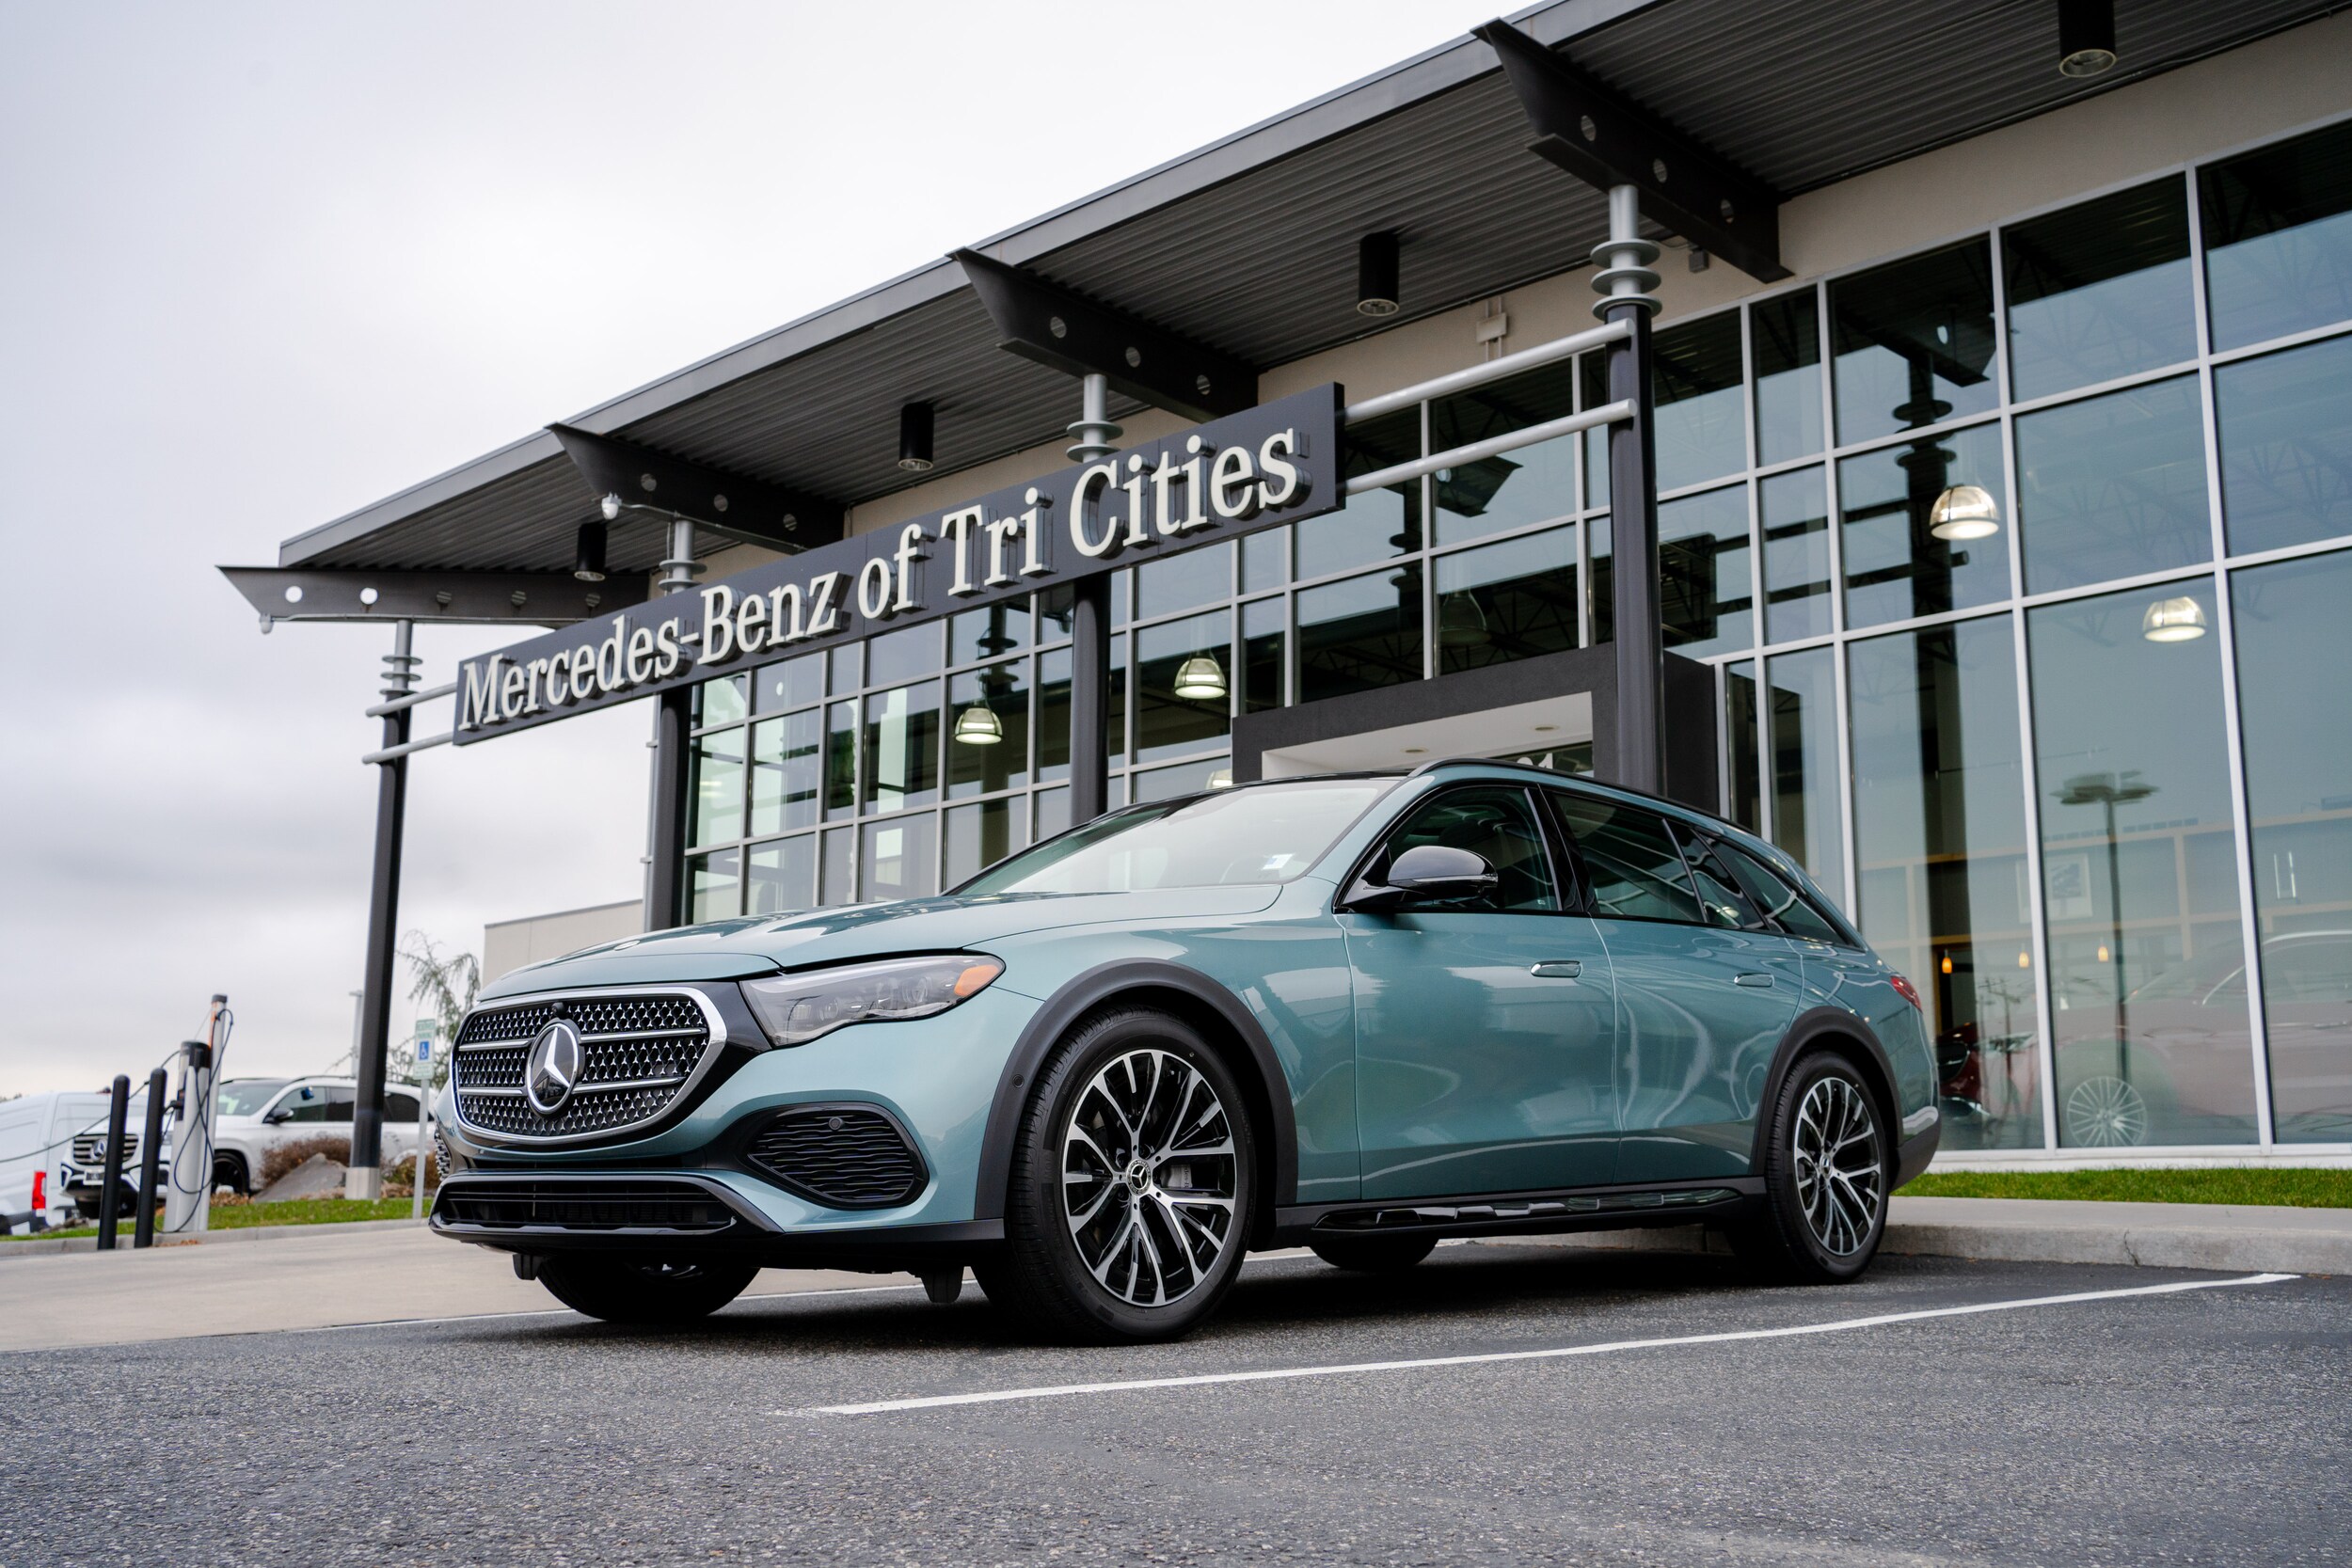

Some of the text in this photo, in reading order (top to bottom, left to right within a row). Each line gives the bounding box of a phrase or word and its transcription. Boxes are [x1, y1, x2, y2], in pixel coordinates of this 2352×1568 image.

[457, 427, 1297, 732] Mercedes-Benz of Tri Cities
